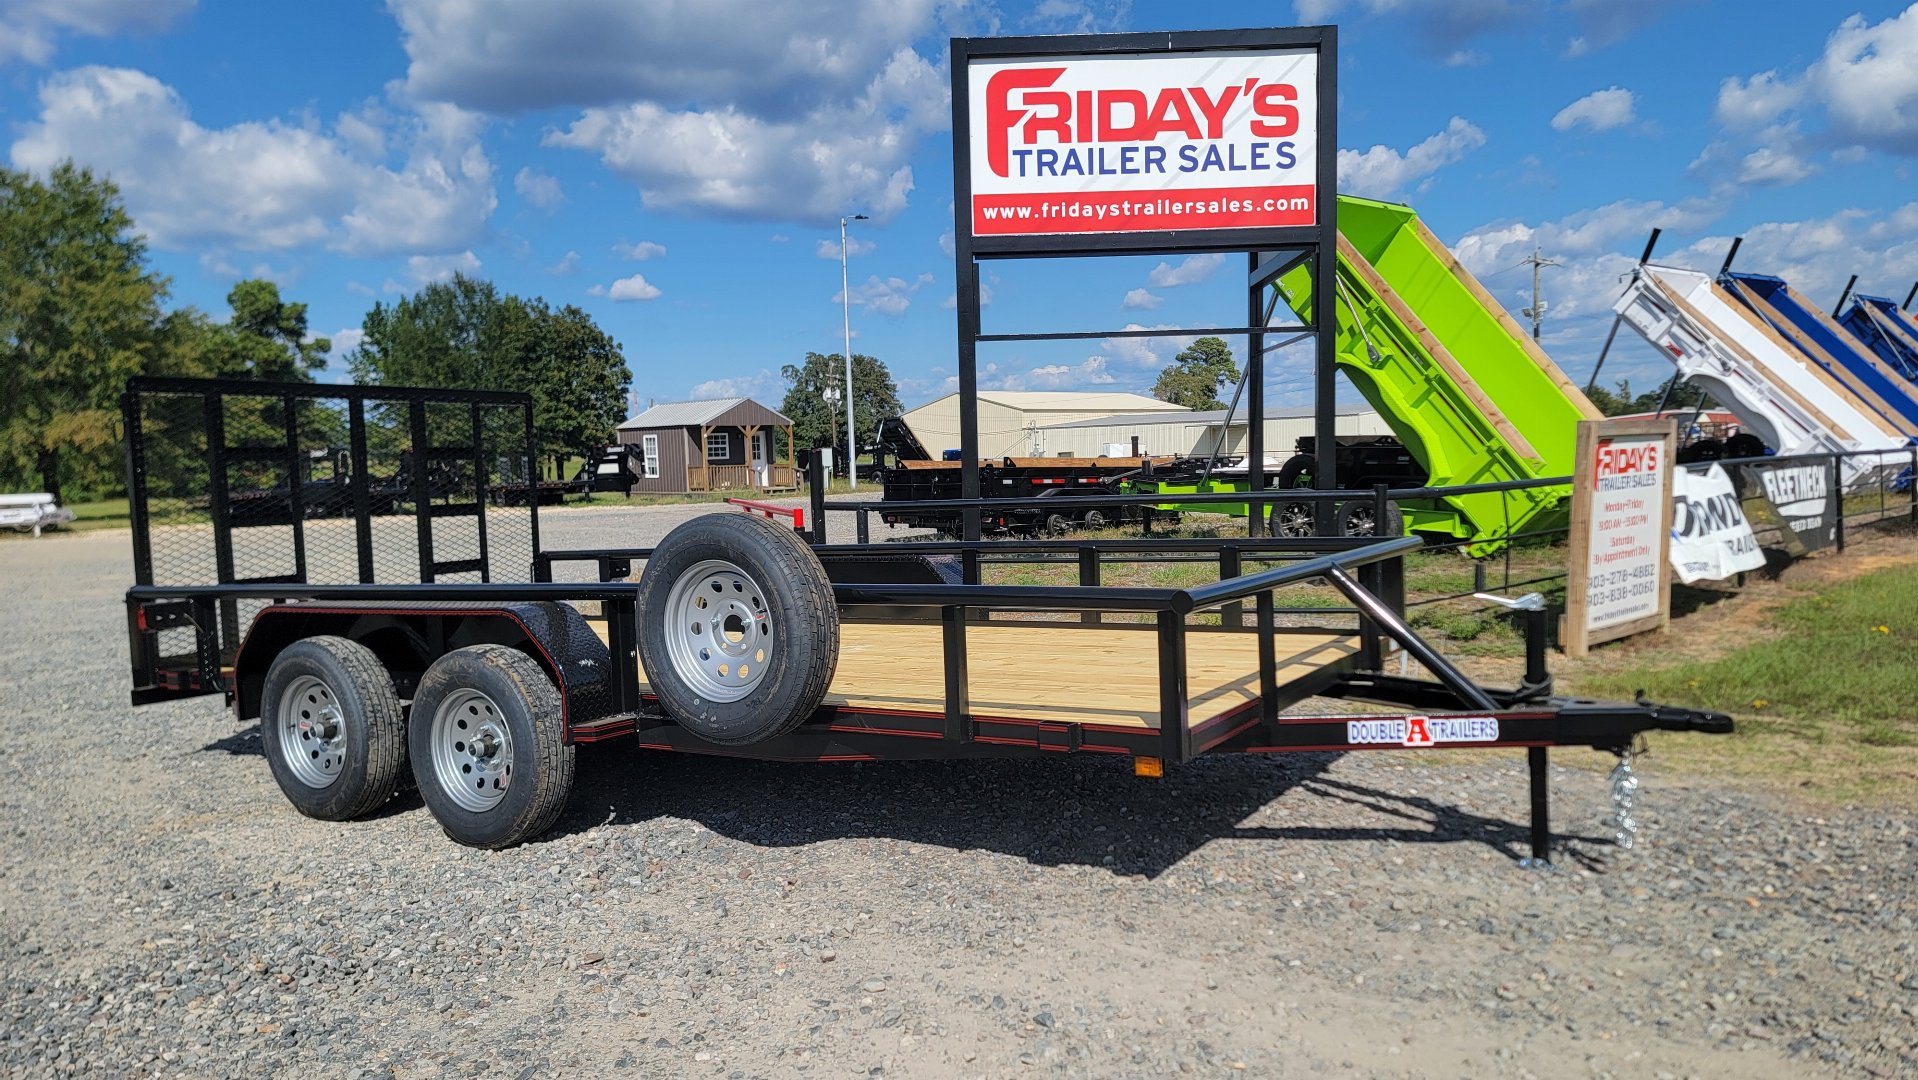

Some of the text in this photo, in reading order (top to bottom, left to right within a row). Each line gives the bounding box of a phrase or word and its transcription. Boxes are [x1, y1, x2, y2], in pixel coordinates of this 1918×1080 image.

[986, 67, 1299, 177] FRIDAY'S
[1013, 141, 1297, 177] TRAILER SALES
[983, 196, 1309, 220] www.fridaystrailersales.com
[1594, 438, 1657, 493] FRIDAY'S
[1599, 472, 1657, 493] TRAILER SALES
[1762, 465, 1827, 505] FLEETNECK
[1351, 718, 1497, 743] DOUBLE A TRAILERS
